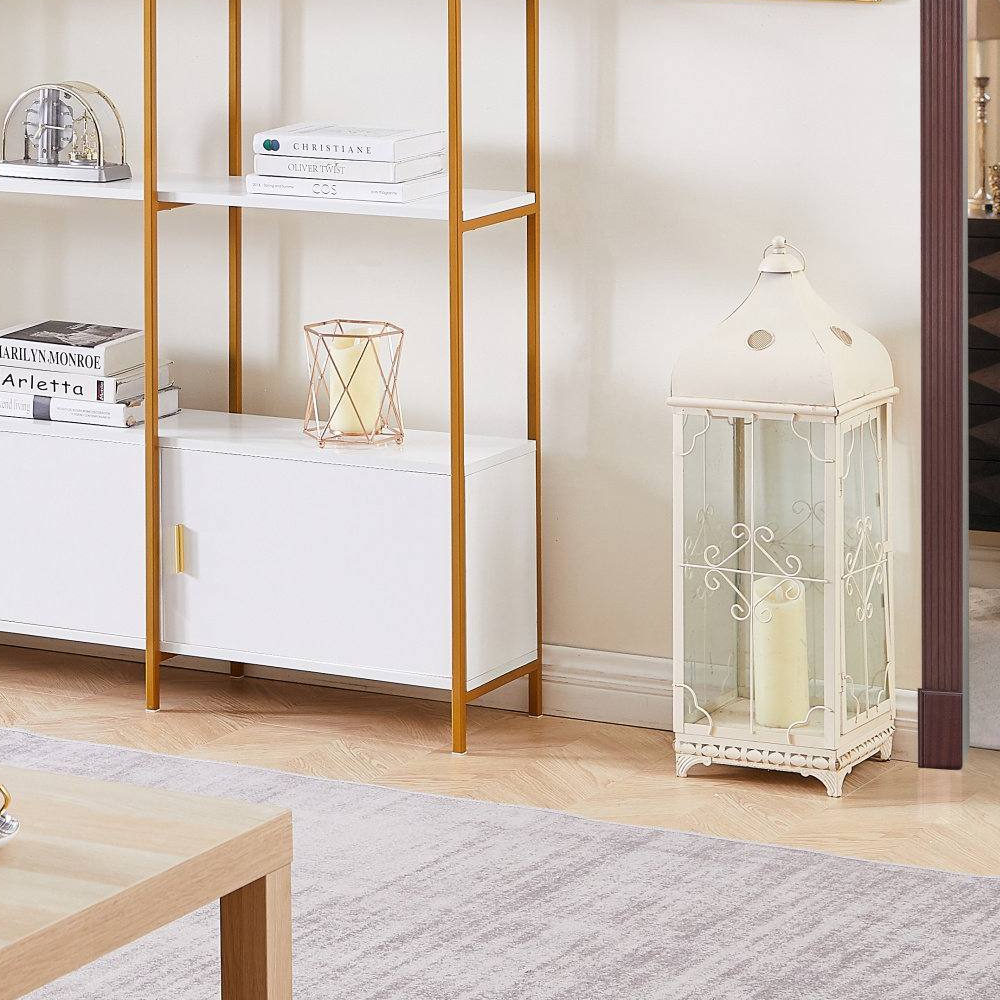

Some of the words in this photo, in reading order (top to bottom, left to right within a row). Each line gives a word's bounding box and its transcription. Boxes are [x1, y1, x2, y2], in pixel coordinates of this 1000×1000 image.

[293, 142, 372, 155] CHRISTIANE
[287, 163, 318, 173] OLIVER
[319, 163, 346, 175] TWIST
[312, 183, 337, 195] COS
[48, 350, 102, 370] MONROE
[1, 373, 84, 396] Arletta
[13, 399, 31, 415] living
